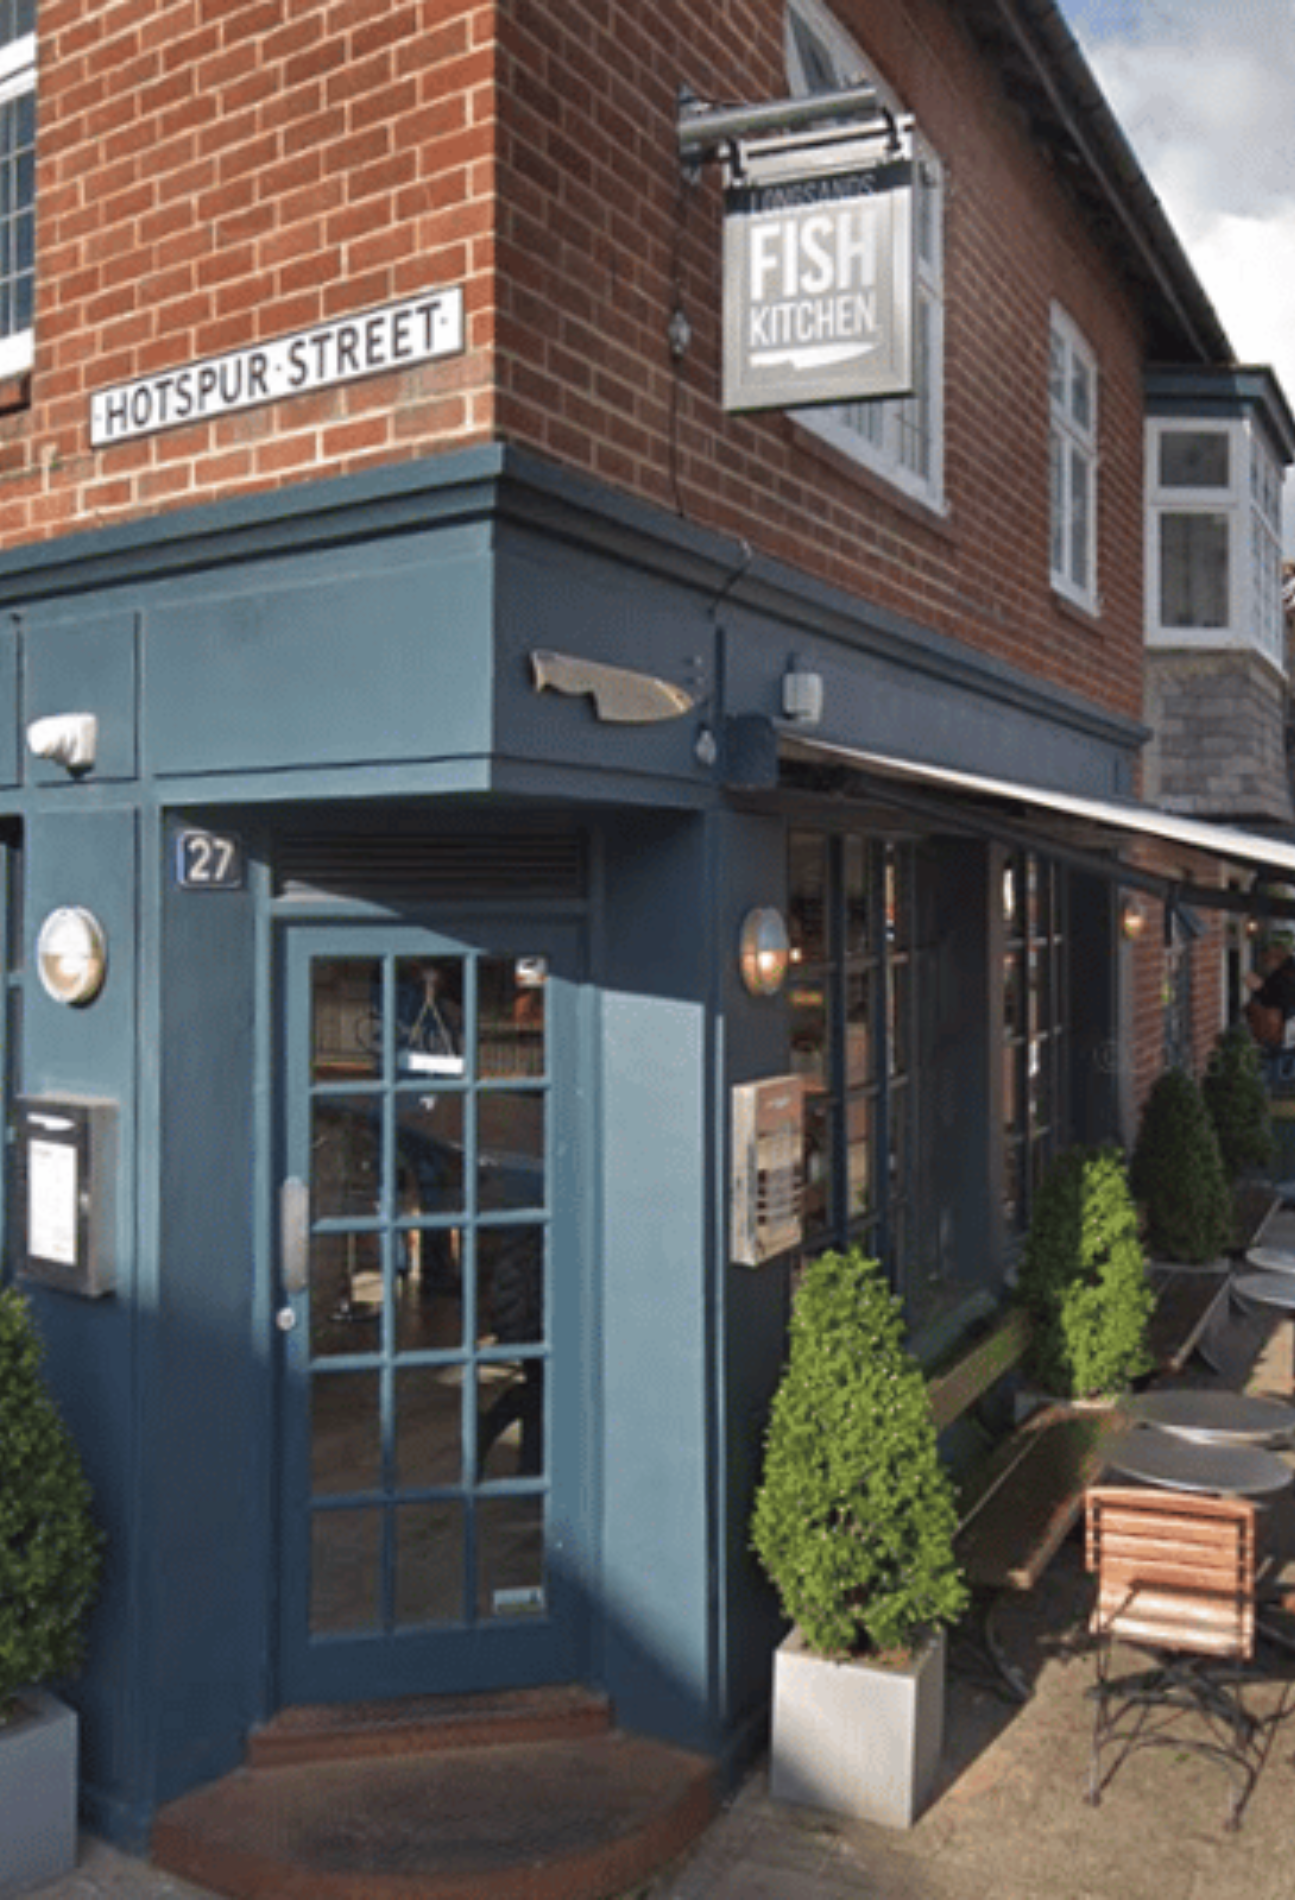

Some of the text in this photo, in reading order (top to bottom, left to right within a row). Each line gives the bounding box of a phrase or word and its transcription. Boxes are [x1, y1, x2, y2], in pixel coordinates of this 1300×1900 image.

[751, 212, 877, 301] FISH
[751, 290, 878, 346] KITCHEN
[105, 301, 442, 435] HOTSPUR STREET
[187, 837, 235, 881] 27
